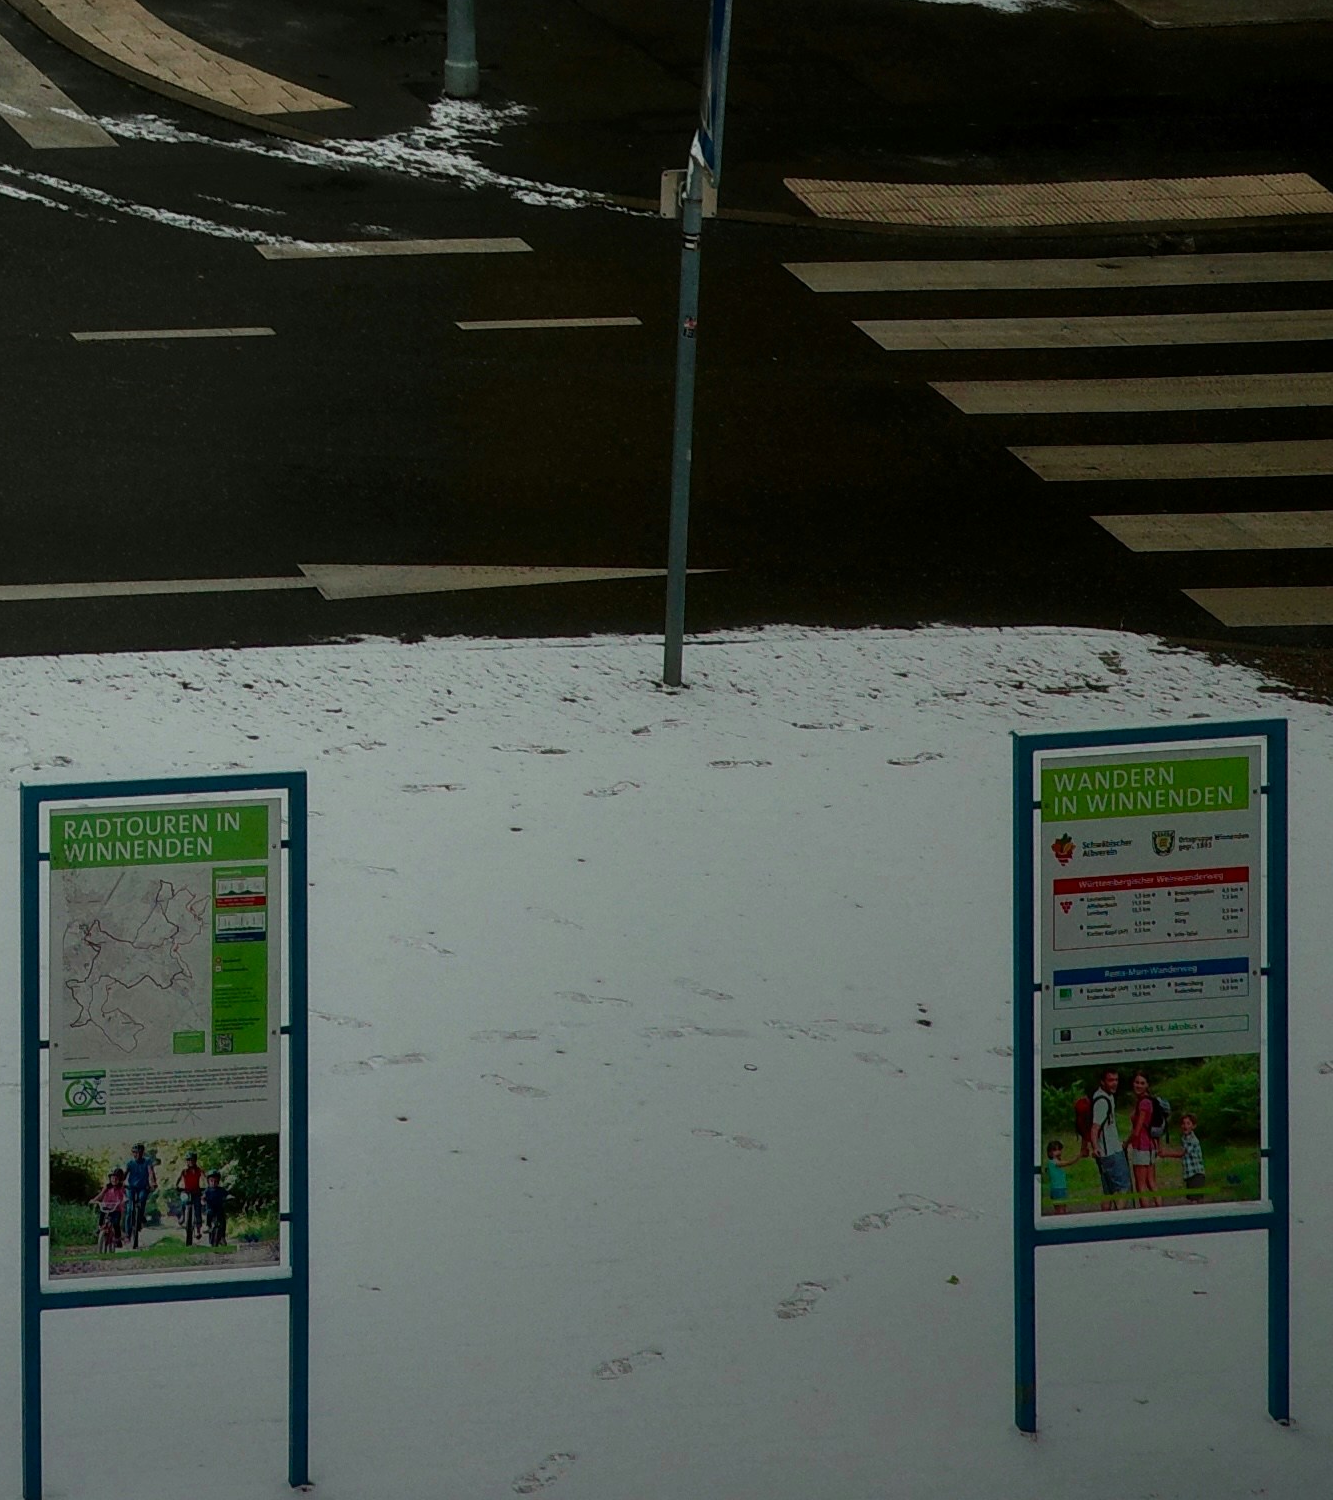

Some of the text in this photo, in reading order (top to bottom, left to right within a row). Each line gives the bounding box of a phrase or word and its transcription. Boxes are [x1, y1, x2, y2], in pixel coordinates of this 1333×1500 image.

[1053, 766, 1174, 793] WANDERN
[1054, 785, 1233, 816] IN WINNENDEN
[63, 811, 240, 840] RADTOUREN IN
[63, 836, 213, 863] WINNENDEN
[1082, 848, 1118, 858] Albverein
[1078, 872, 1224, 890] Württembergischer Weinwanderweg
